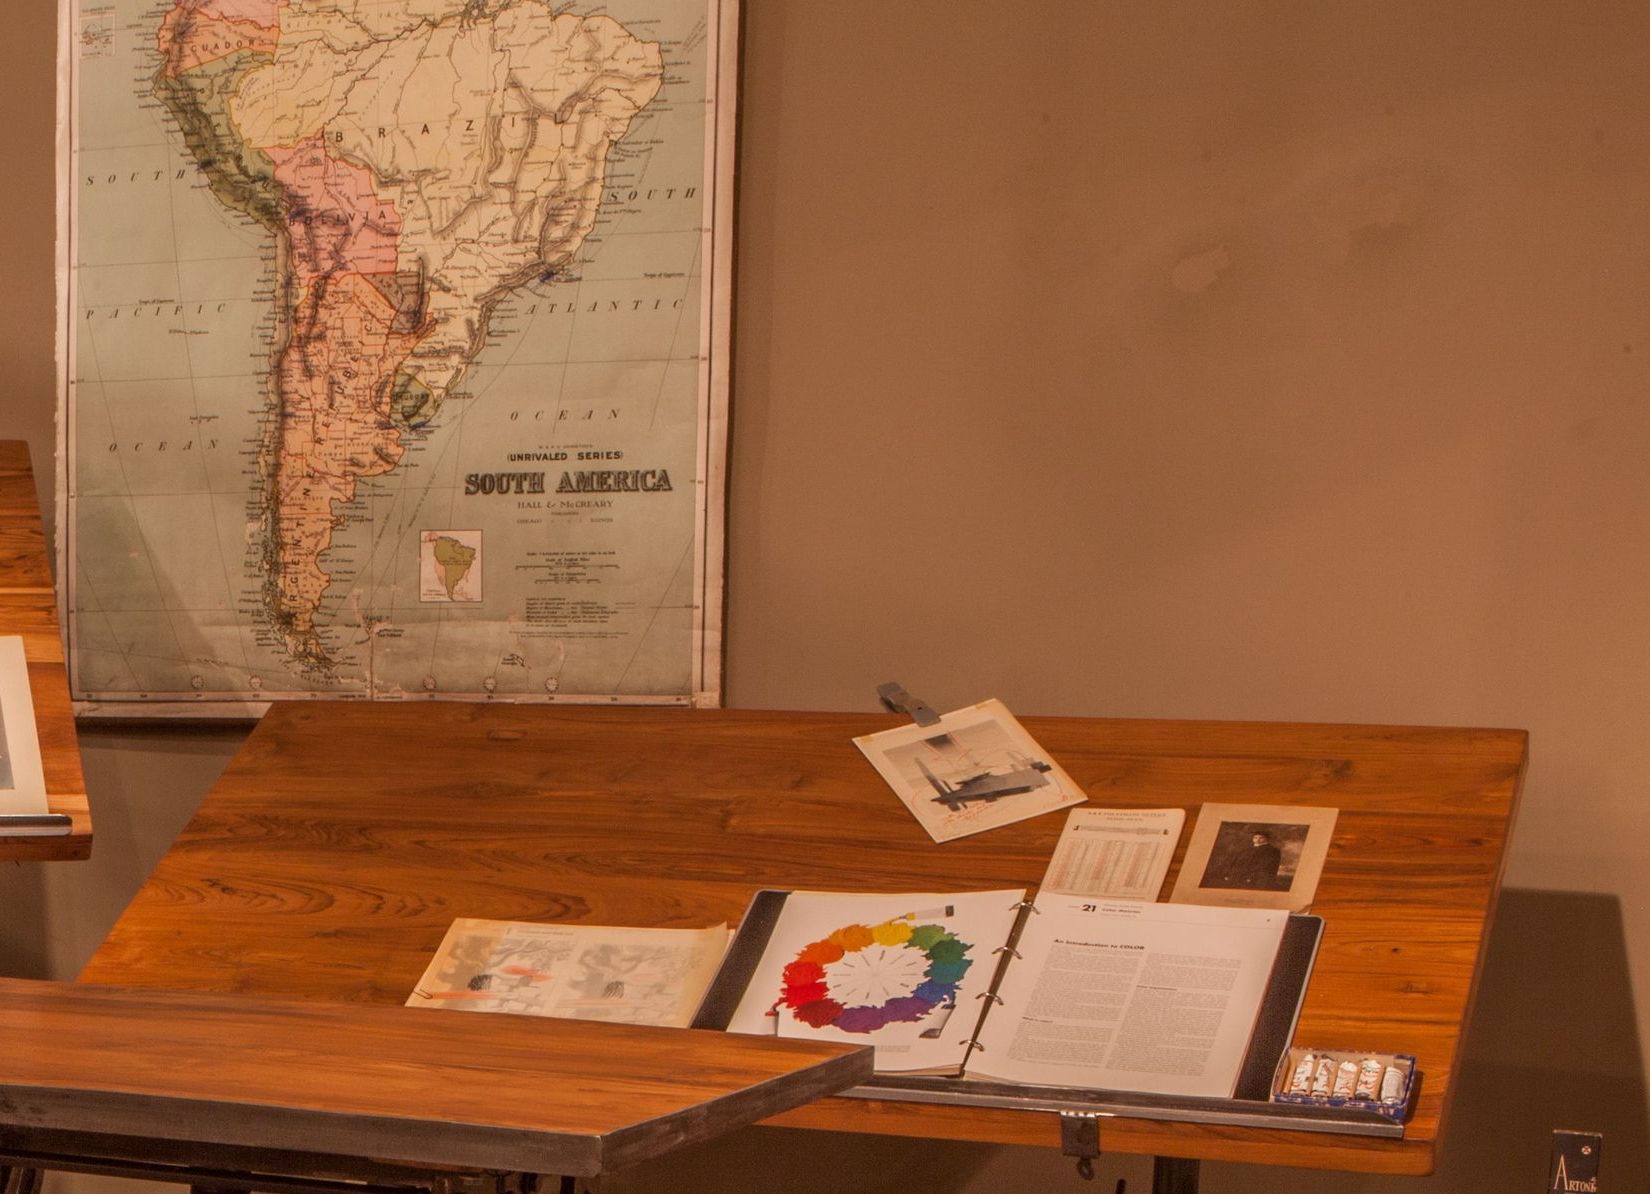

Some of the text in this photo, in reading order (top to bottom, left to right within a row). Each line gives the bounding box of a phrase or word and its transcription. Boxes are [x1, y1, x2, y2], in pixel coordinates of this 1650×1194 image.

[86, 169, 187, 186] SOUTH
[609, 187, 697, 202] SOUTH
[85, 302, 227, 320] PACIFIC
[525, 298, 684, 315] ATLANTIC
[510, 408, 621, 422] OCEAN
[108, 439, 219, 453] OCEAN
[464, 469, 673, 496] SOUTH AMERICA
[517, 501, 543, 509] HALL
[1082, 904, 1097, 912] 21
